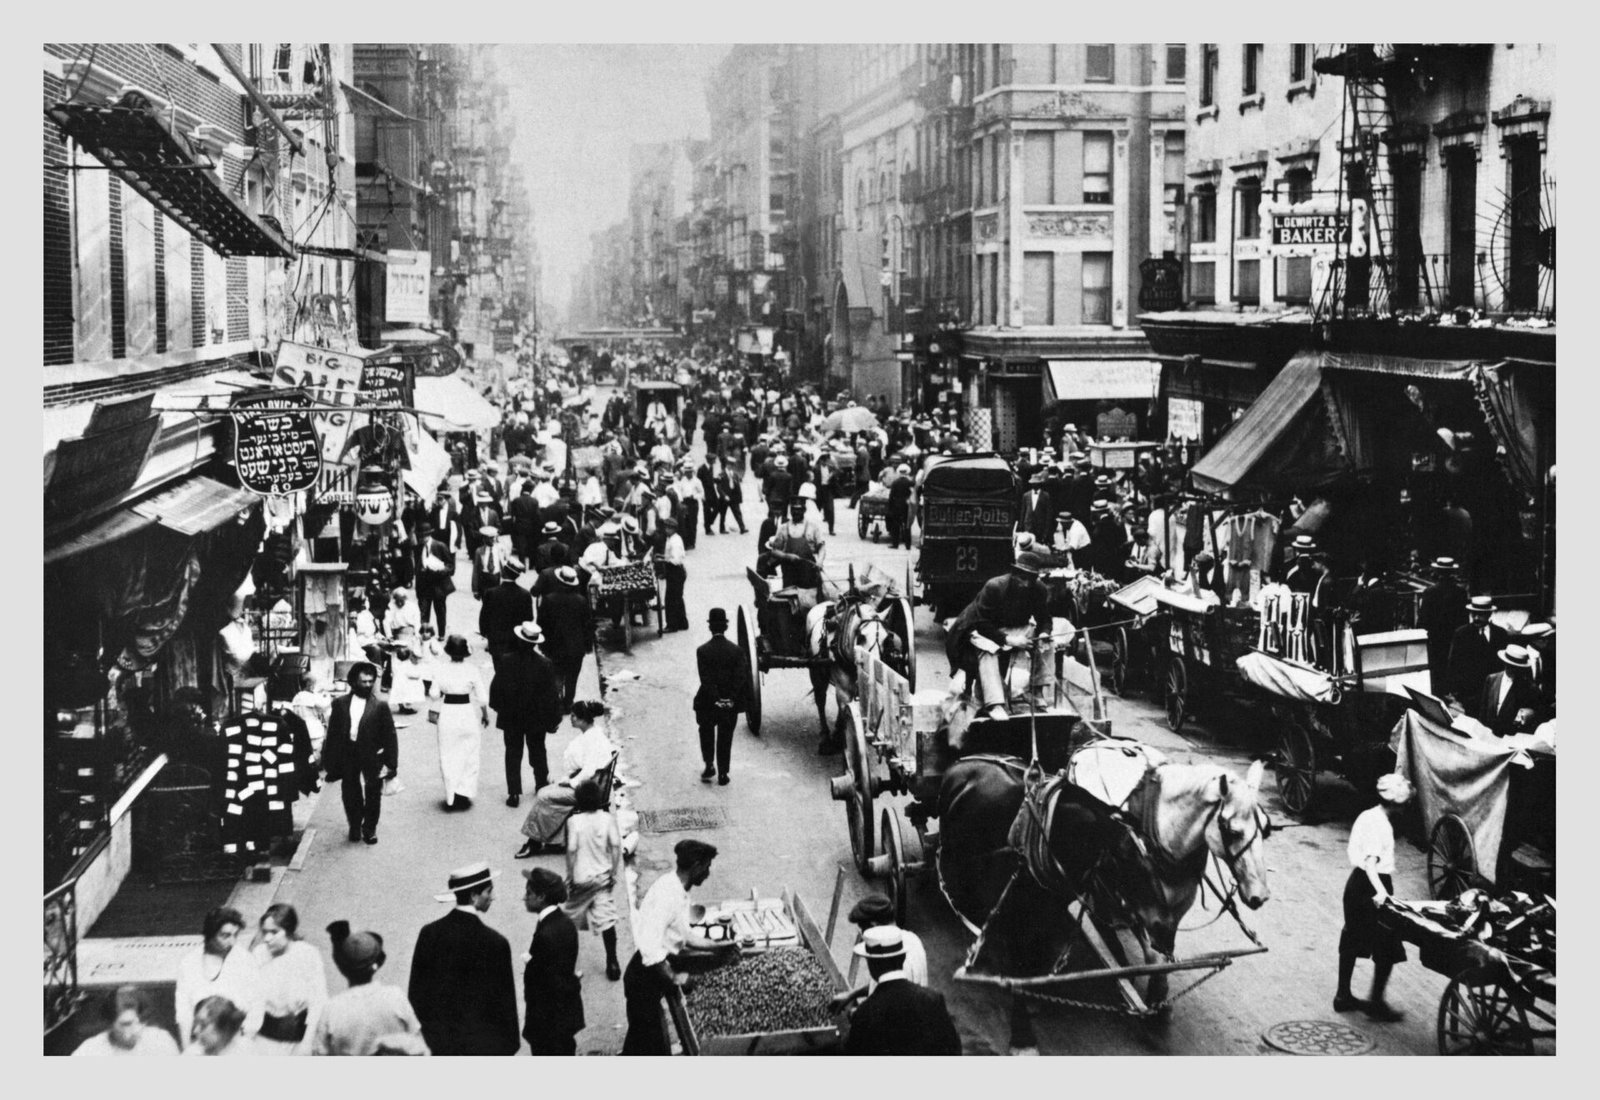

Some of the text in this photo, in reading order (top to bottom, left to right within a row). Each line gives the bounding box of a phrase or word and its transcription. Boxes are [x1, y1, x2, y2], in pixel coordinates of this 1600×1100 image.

[1280, 227, 1347, 243] BAKERY
[306, 352, 341, 370] BIG
[275, 365, 356, 407] SALE
[254, 416, 293, 431] כשר
[313, 409, 346, 427] NG
[271, 483, 291, 494] 80
[956, 545, 979, 571] 23
